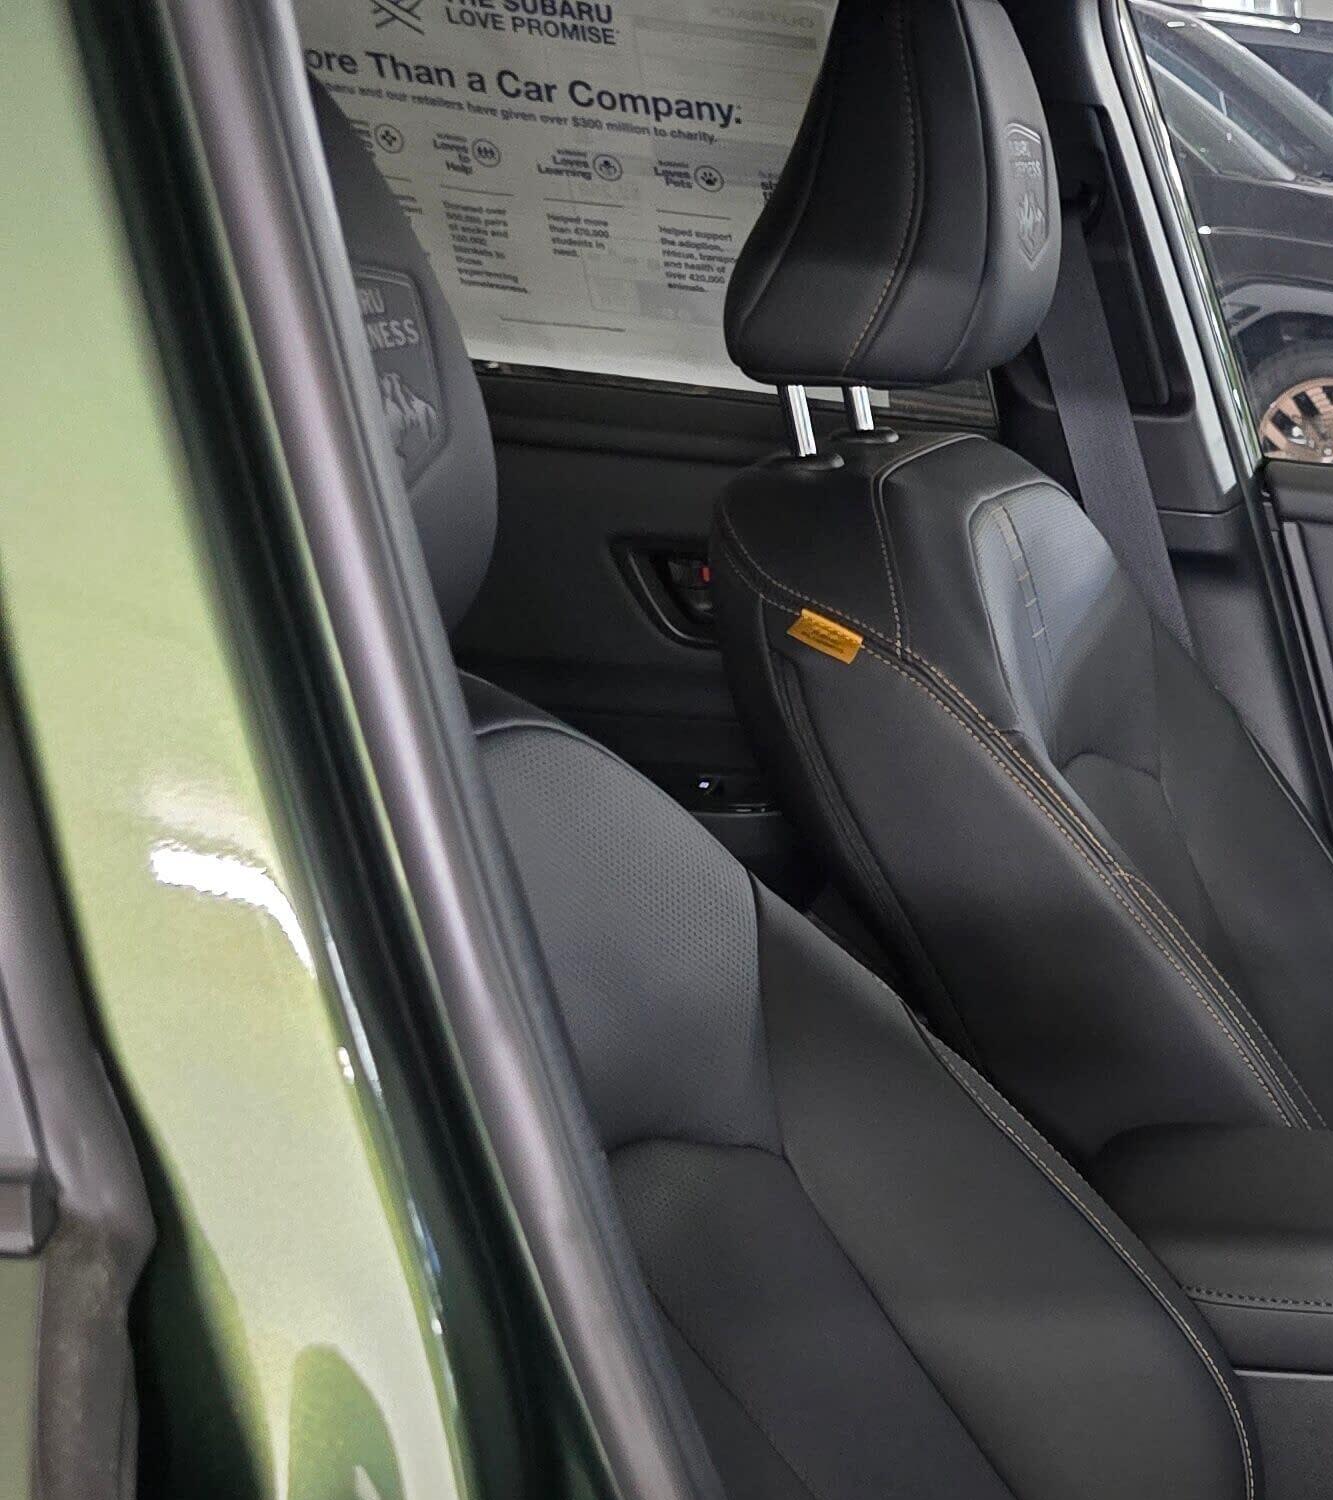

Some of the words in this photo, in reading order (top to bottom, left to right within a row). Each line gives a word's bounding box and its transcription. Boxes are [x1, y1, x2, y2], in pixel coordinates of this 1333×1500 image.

[445, 7, 506, 32] LOVE
[511, 17, 617, 46] PROMISE
[503, 0, 612, 24] SUBARU
[304, 49, 358, 75] ore
[364, 51, 456, 89] Than
[466, 70, 488, 94] a
[496, 69, 558, 104] Car
[467, 102, 498, 117] have
[501, 109, 536, 124] given
[540, 114, 568, 126] over
[607, 122, 650, 136] million
[653, 126, 668, 138] to
